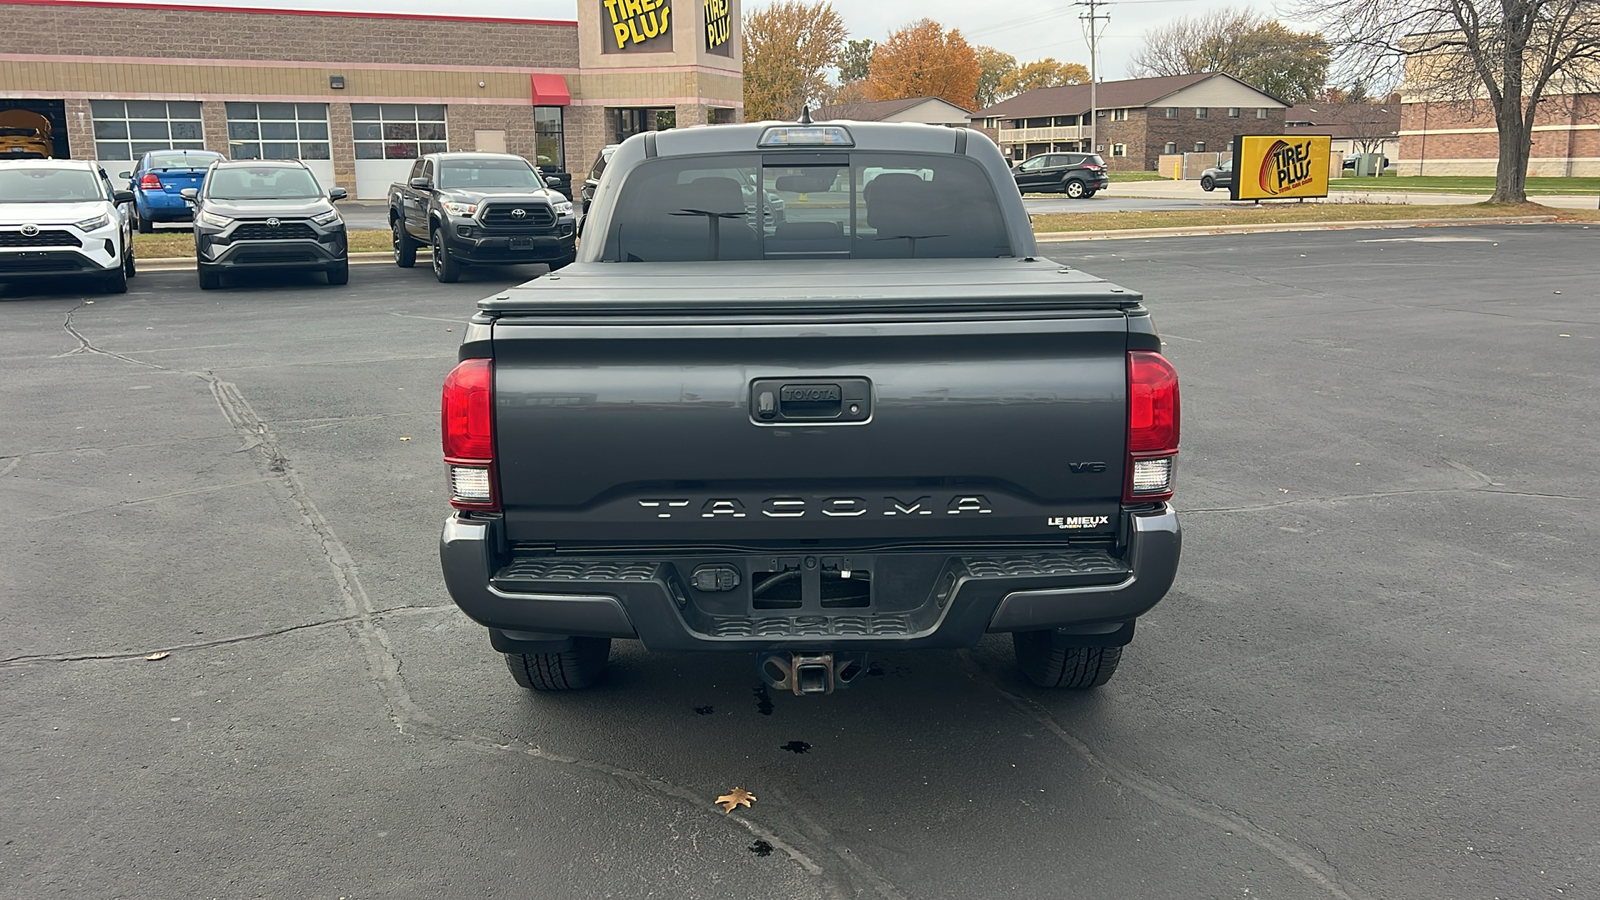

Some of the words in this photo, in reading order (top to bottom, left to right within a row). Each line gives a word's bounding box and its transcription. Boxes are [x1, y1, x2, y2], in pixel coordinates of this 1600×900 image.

[604, 0, 664, 24] TIRE
[613, 6, 670, 49] PLUS
[707, 14, 731, 49] PLUS
[1273, 140, 1312, 170] TIRES
[1277, 159, 1312, 189] PLUS
[786, 389, 837, 400] TOYOTA
[1069, 461, 1106, 474] V6
[639, 495, 992, 518] TACOMA
[1048, 517, 1064, 526] LE
[1067, 516, 1109, 525] MIEUX
